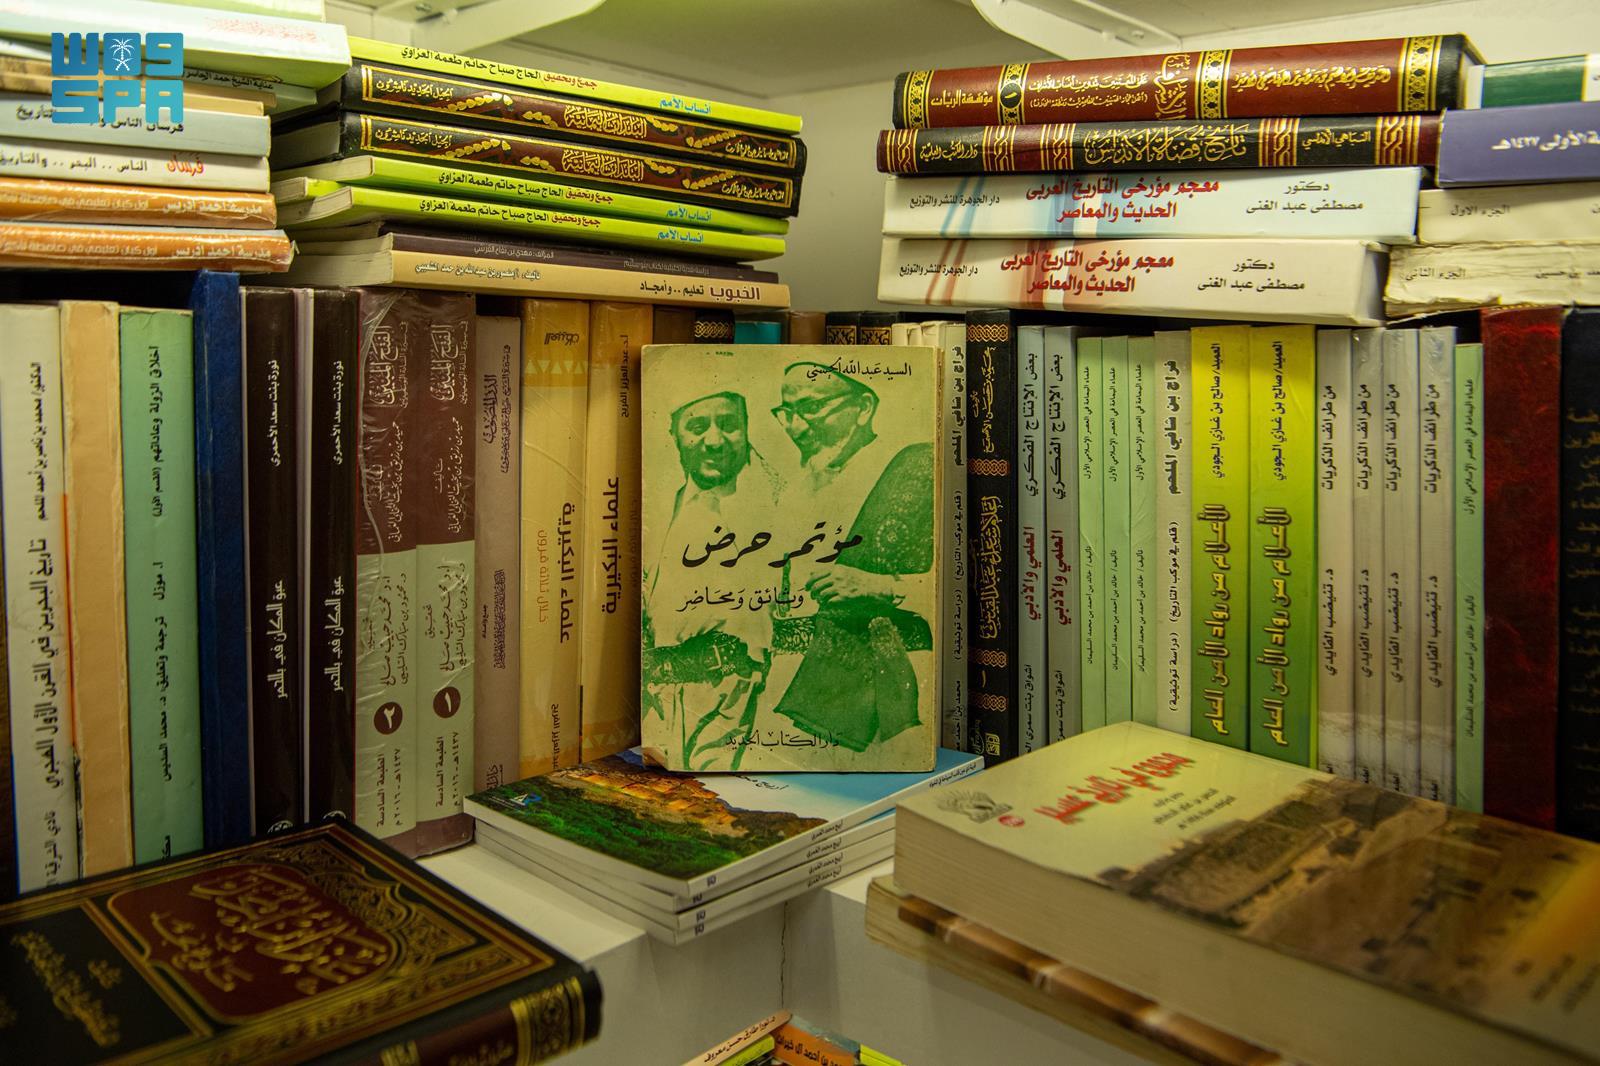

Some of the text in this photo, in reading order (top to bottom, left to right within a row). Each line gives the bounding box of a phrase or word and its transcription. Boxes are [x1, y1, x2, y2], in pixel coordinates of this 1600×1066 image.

[401, 47, 433, 60] العزاوي
[463, 58, 487, 70] حاتم
[489, 63, 515, 75] صباح
[516, 70, 541, 80] الحاج
[1072, 178, 1118, 199] التاريخ
[1175, 180, 1219, 198] معجم
[1284, 181, 1330, 195] دكتور
[419, 199, 449, 212] العزاوي
[910, 196, 938, 208] والتوزيع
[987, 194, 1000, 205] دار
[1282, 202, 1307, 214] عبد
[1311, 199, 1364, 214] مصطفى
[477, 204, 500, 217] حاتم
[501, 208, 525, 220] صباح
[526, 212, 550, 223] الحاج
[1056, 202, 1177, 222] الحديث والمعاصر
[1041, 250, 1083, 271] التاريخ
[1132, 255, 1174, 270] معجم
[1232, 259, 1275, 273] دكتور
[899, 265, 923, 277] والتوزيع
[968, 265, 978, 275] دار
[683, 284, 705, 297] تعليم
[1026, 277, 1135, 296] الحديث والمعاصر
[1230, 279, 1253, 292] عبد
[1256, 277, 1306, 292] مصطفى
[710, 286, 760, 303] الخبوب
[431, 324, 459, 359] الفتح
[268, 359, 280, 381] نورة
[880, 363, 912, 382] السيد
[1164, 360, 1180, 391] فراج
[268, 381, 280, 401] بنت
[1167, 395, 1181, 412] بن
[1210, 402, 1224, 414] بن
[269, 402, 279, 424] سعد
[1022, 353, 1039, 497] بعض الإنتاج الفكري
[1083, 416, 1092, 434] العصر
[1209, 417, 1225, 442] غازي
[149, 418, 165, 463] وعاداتهم
[1321, 385, 1337, 491] من طرائف الذكريات
[1164, 454, 1181, 494] الملحم
[601, 476, 622, 614] علماء البكيرية
[682, 521, 772, 568] حرض
[768, 521, 863, 569] مؤتمر
[28, 538, 53, 577] تاريخ
[1021, 526, 1042, 621] العلمي والأدبي
[29, 580, 55, 632] البحرين
[324, 598, 344, 637] المكان
[1197, 504, 1231, 735] الأعلام من رواد الأمن العام
[32, 662, 57, 698] القرن
[33, 701, 59, 735] الأول
[822, 732, 840, 748] دار
[35, 738, 64, 789] الهجري
